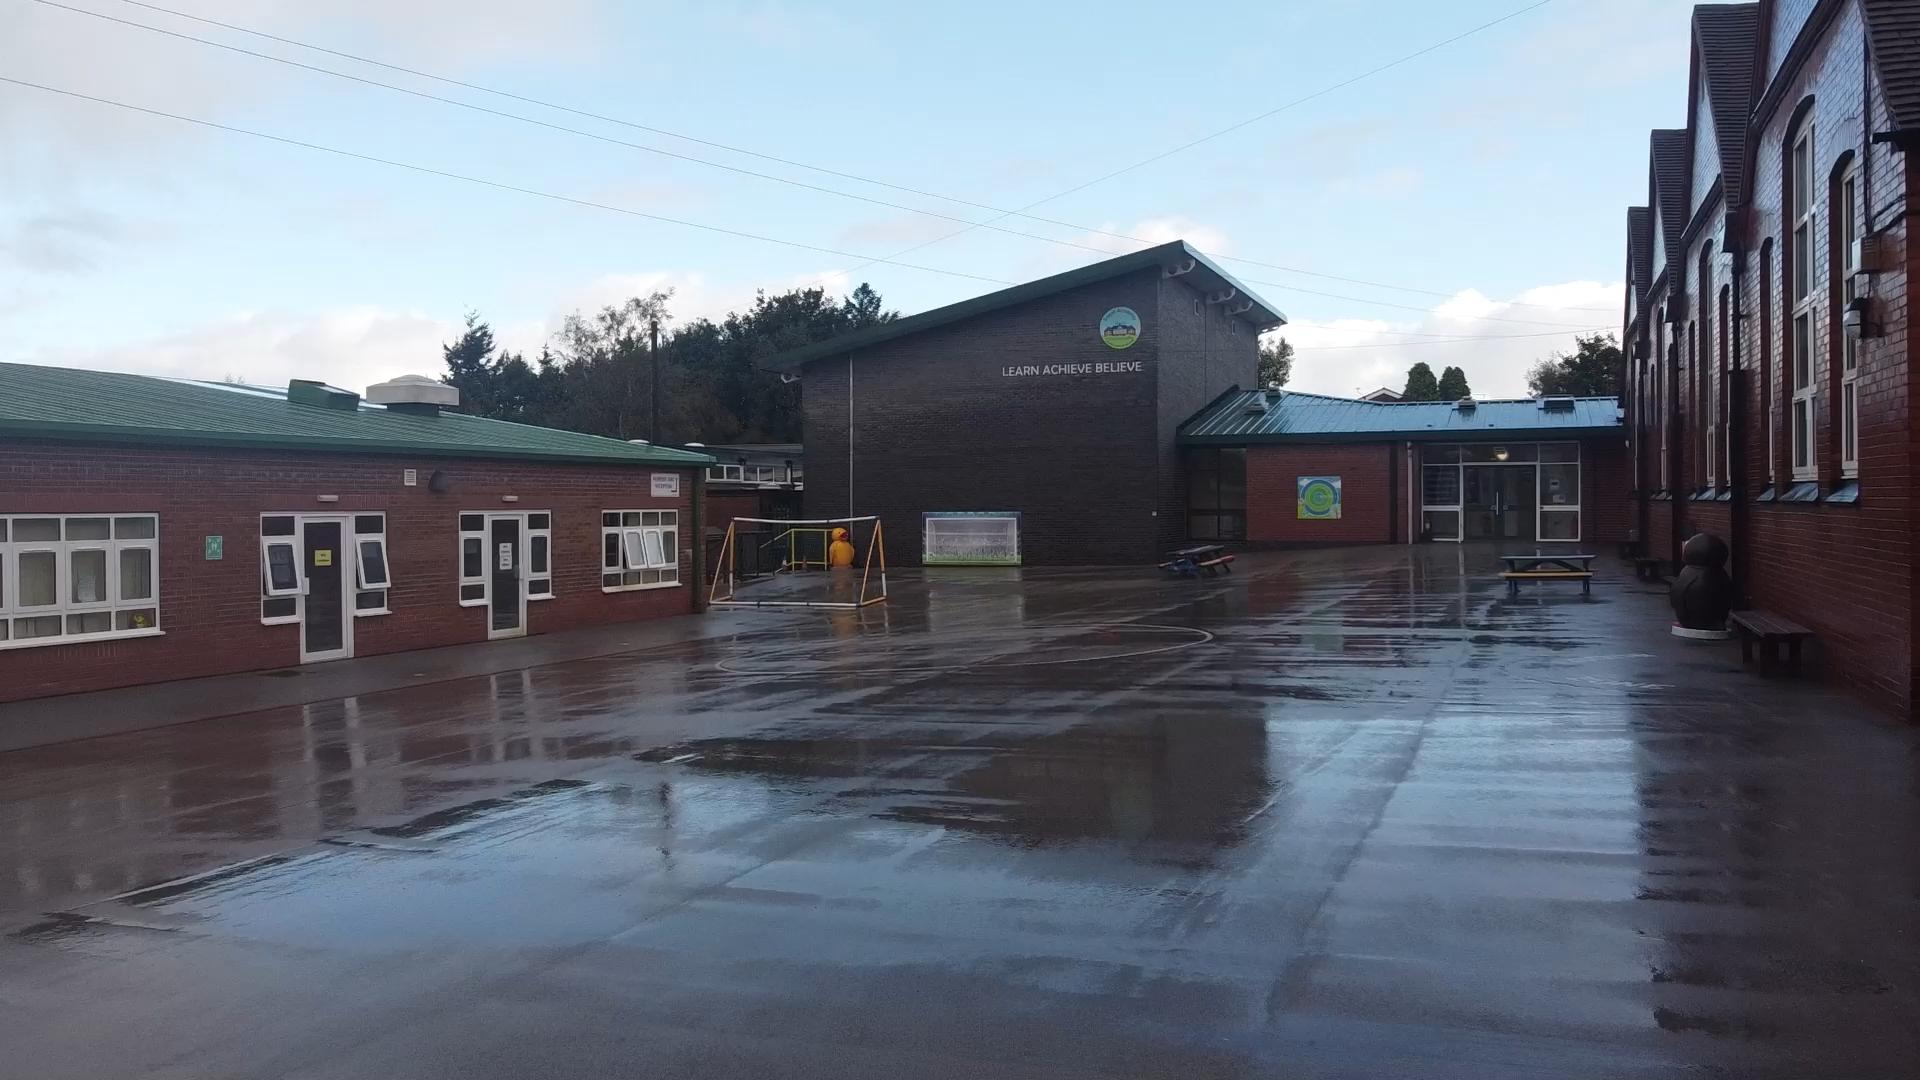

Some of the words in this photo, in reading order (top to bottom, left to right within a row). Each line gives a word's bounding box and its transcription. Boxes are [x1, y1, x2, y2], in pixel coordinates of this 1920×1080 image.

[1002, 365, 1039, 377] LEARN
[1042, 363, 1092, 375] ACHIEVE
[1095, 361, 1142, 373] BELIEVE
